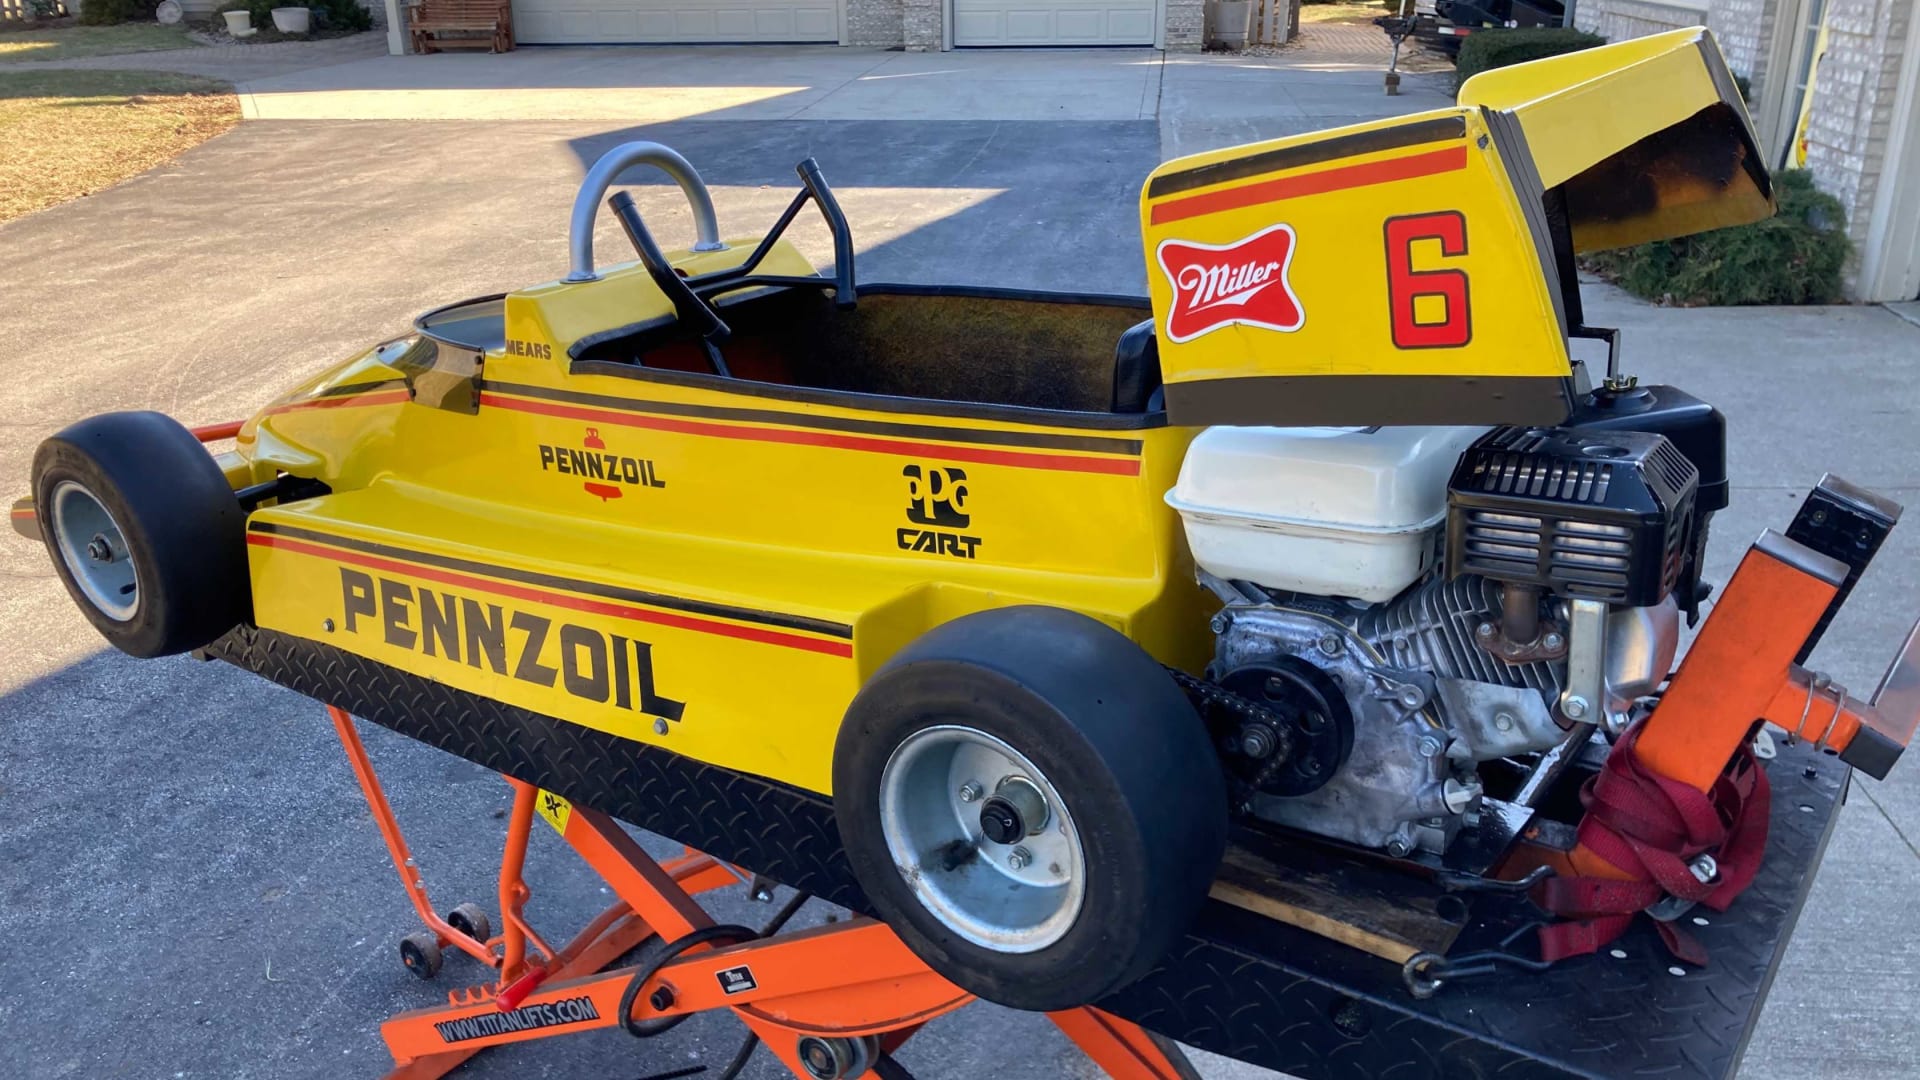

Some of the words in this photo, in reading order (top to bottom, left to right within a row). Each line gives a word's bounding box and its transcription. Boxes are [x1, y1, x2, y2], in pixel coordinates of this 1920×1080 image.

[1178, 261, 1280, 309] Miller
[1383, 210, 1472, 350] 6
[506, 339, 551, 360] MEARS
[539, 444, 666, 488] PENNZOIL
[897, 527, 982, 559] CART
[339, 567, 686, 723] PENNZOIL
[437, 998, 599, 1042] WWW.TITANLIFTS.COM
